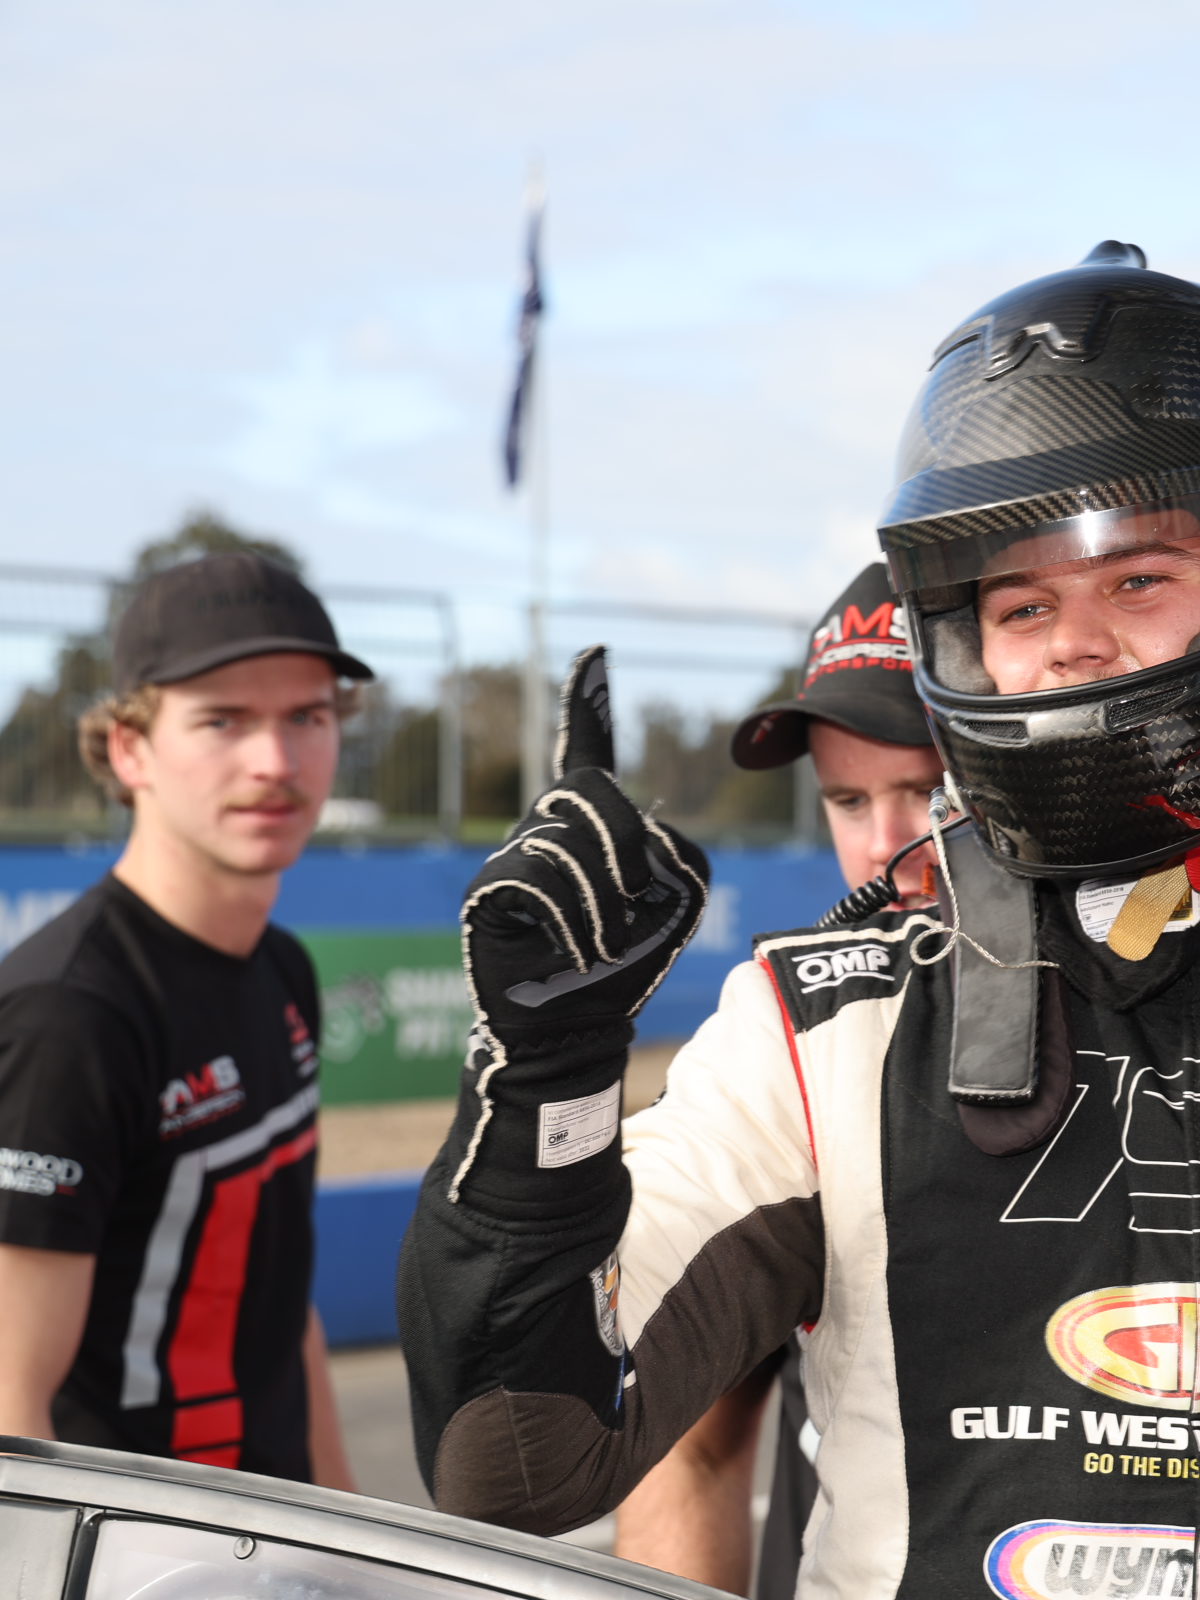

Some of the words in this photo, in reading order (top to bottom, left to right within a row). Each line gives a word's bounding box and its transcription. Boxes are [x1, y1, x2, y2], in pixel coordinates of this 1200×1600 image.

[796, 949, 891, 984] OMP
[158, 1054, 240, 1114] AMS
[548, 1131, 569, 1144] OMP
[0, 1148, 83, 1187] WOOD
[950, 1405, 1070, 1440] GULF
[1084, 1452, 1114, 1474] GO
[1119, 1454, 1162, 1477] THE
